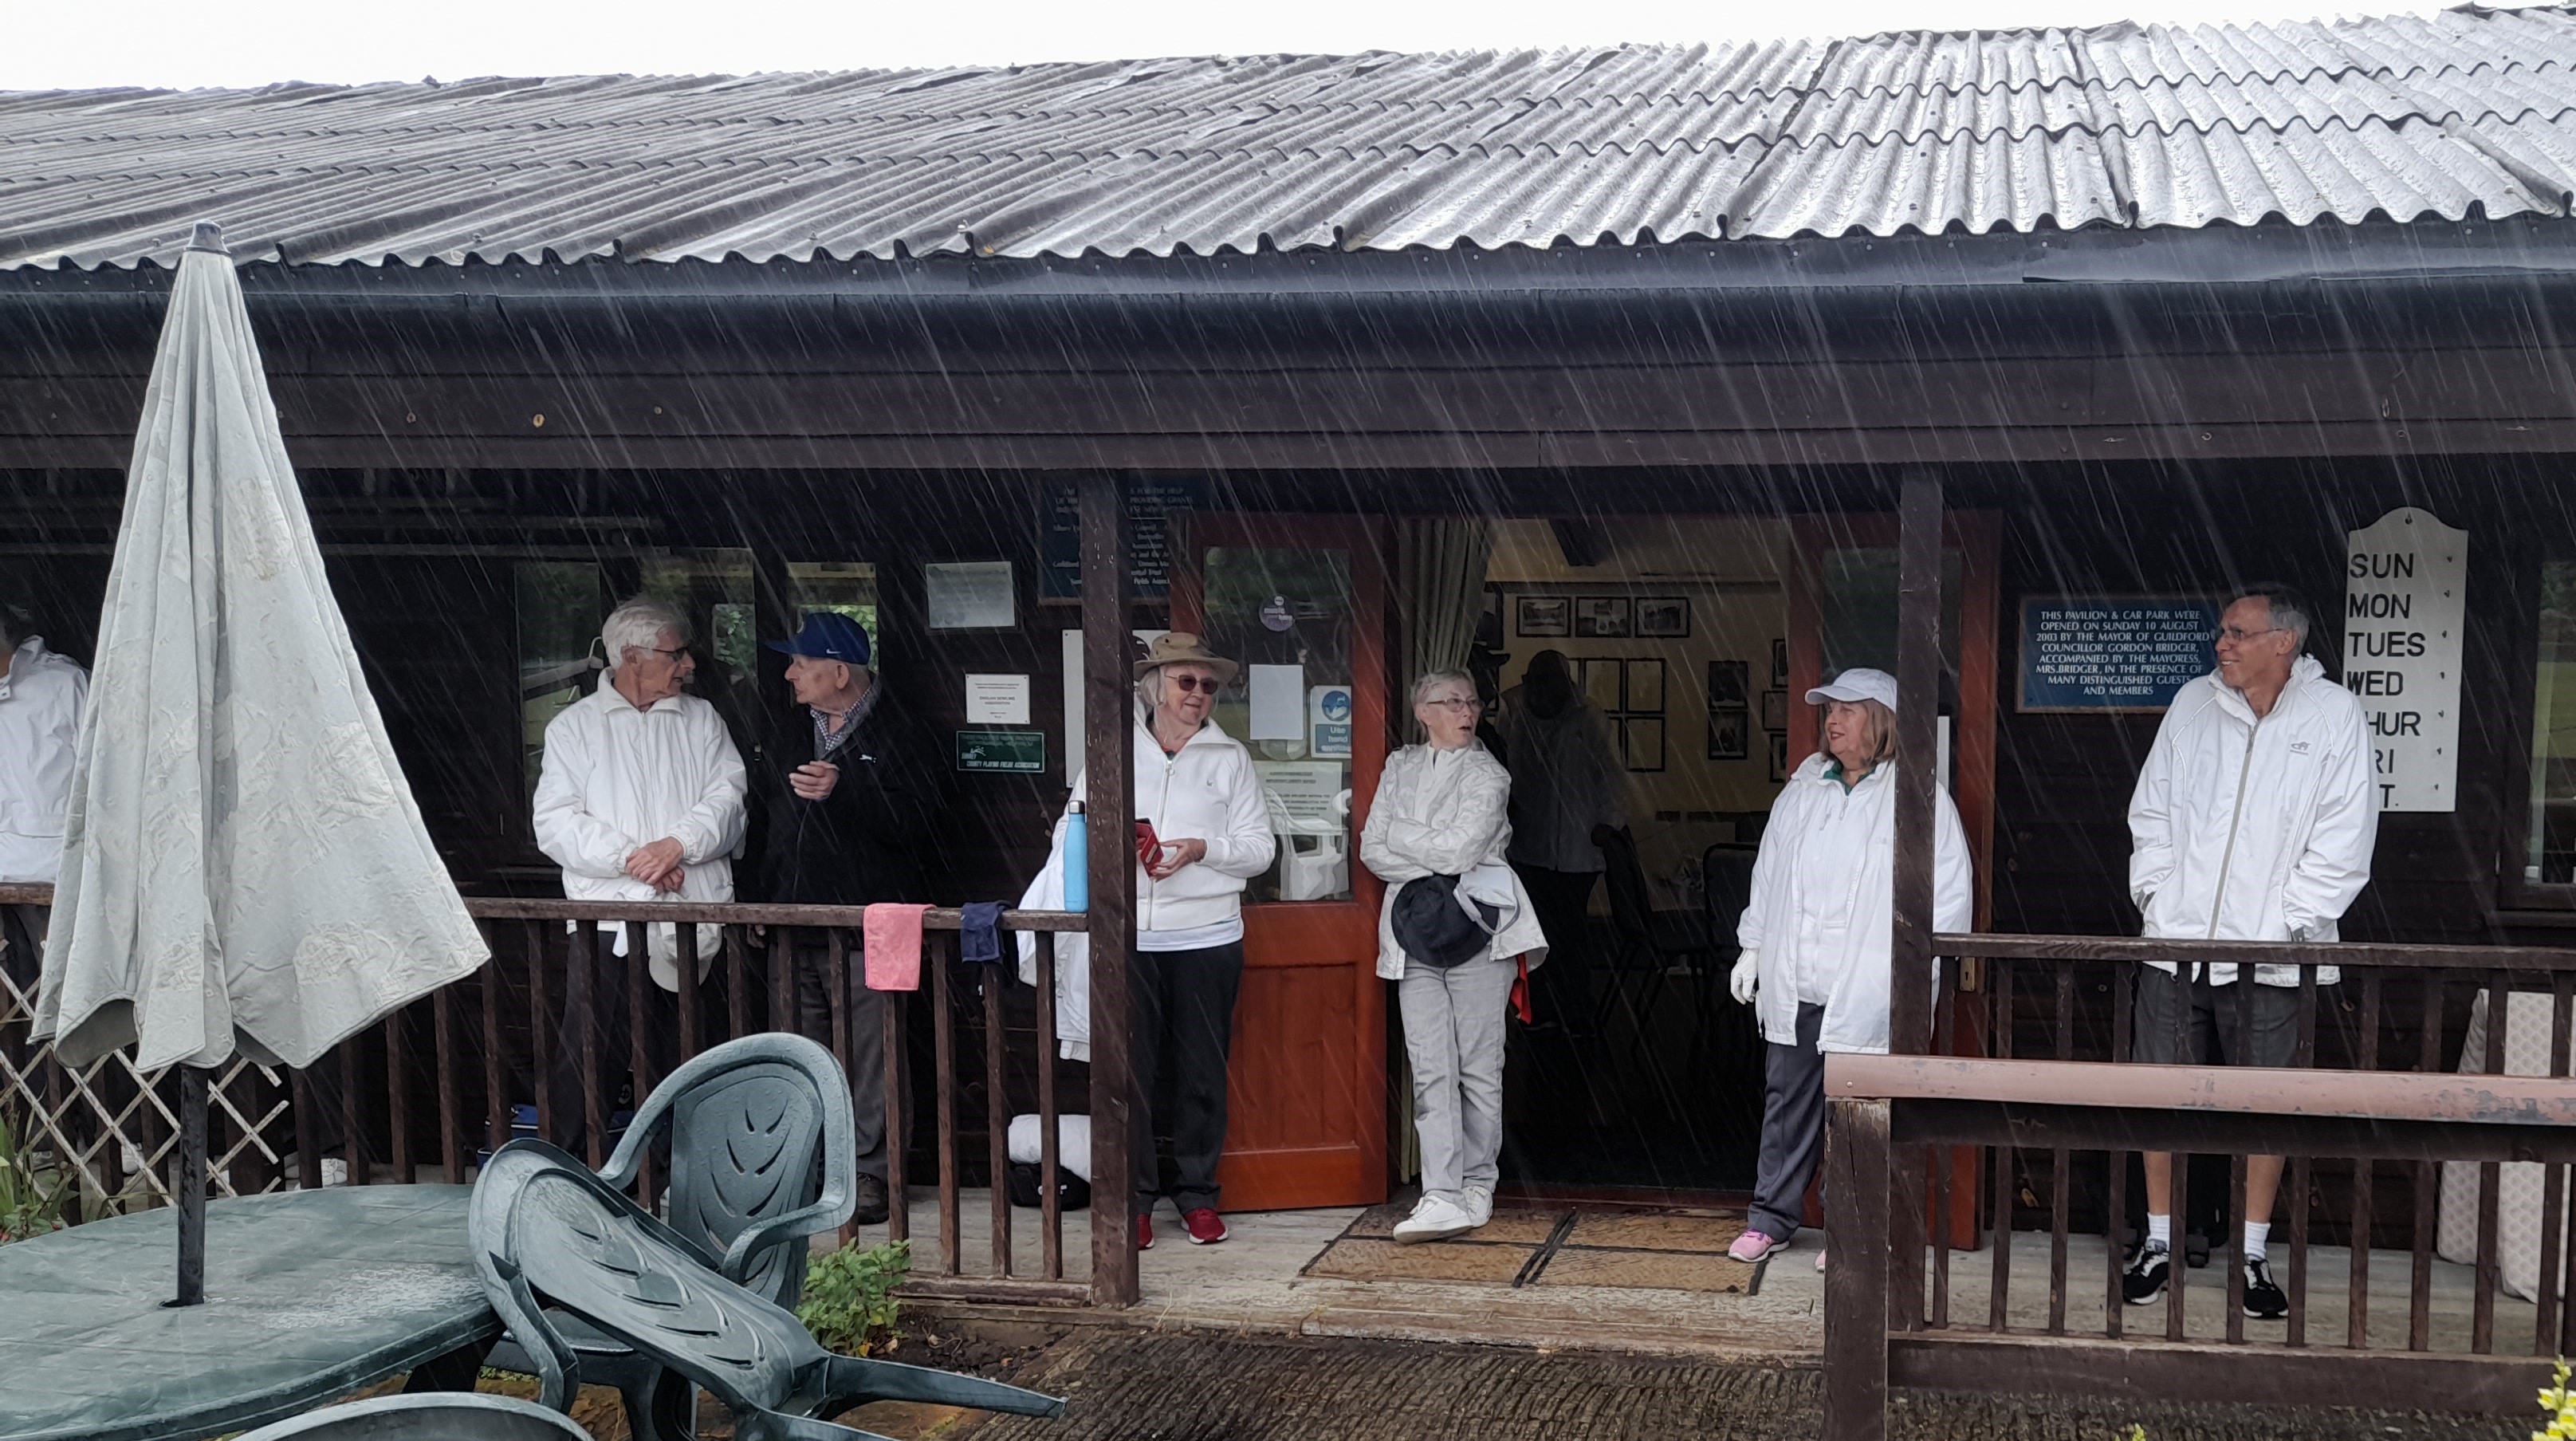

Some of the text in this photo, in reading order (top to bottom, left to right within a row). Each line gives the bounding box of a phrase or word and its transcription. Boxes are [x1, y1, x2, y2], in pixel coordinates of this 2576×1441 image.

[2350, 553, 2413, 578] SUN
[2349, 593, 2411, 619] MON
[2040, 611, 2200, 620] THIS PAVILION & CAR PARK WERE
[2040, 622, 2079, 631] OPENED
[2082, 622, 2099, 631] ON
[2145, 621, 2156, 630] 10
[2160, 621, 2199, 630] AUGUST
[2036, 632, 2210, 641] 2003 BY THE MAYOR OF GUILDFORD
[2041, 643, 2200, 652] COUNCILLOR GORDON BRIDGER,
[2348, 632, 2426, 657] TUES
[2039, 654, 2200, 663] ACCOMPANIED BY THE MAYORESS,
[2189, 665, 2202, 674] OF
[2047, 675, 2191, 684] MANY DISTINGUISHED GUESTS
[2346, 671, 2404, 696] WED
[2082, 686, 2153, 695] AND MEMBERS
[2365, 711, 2421, 737] HUR
[2375, 749, 2394, 774] RI
